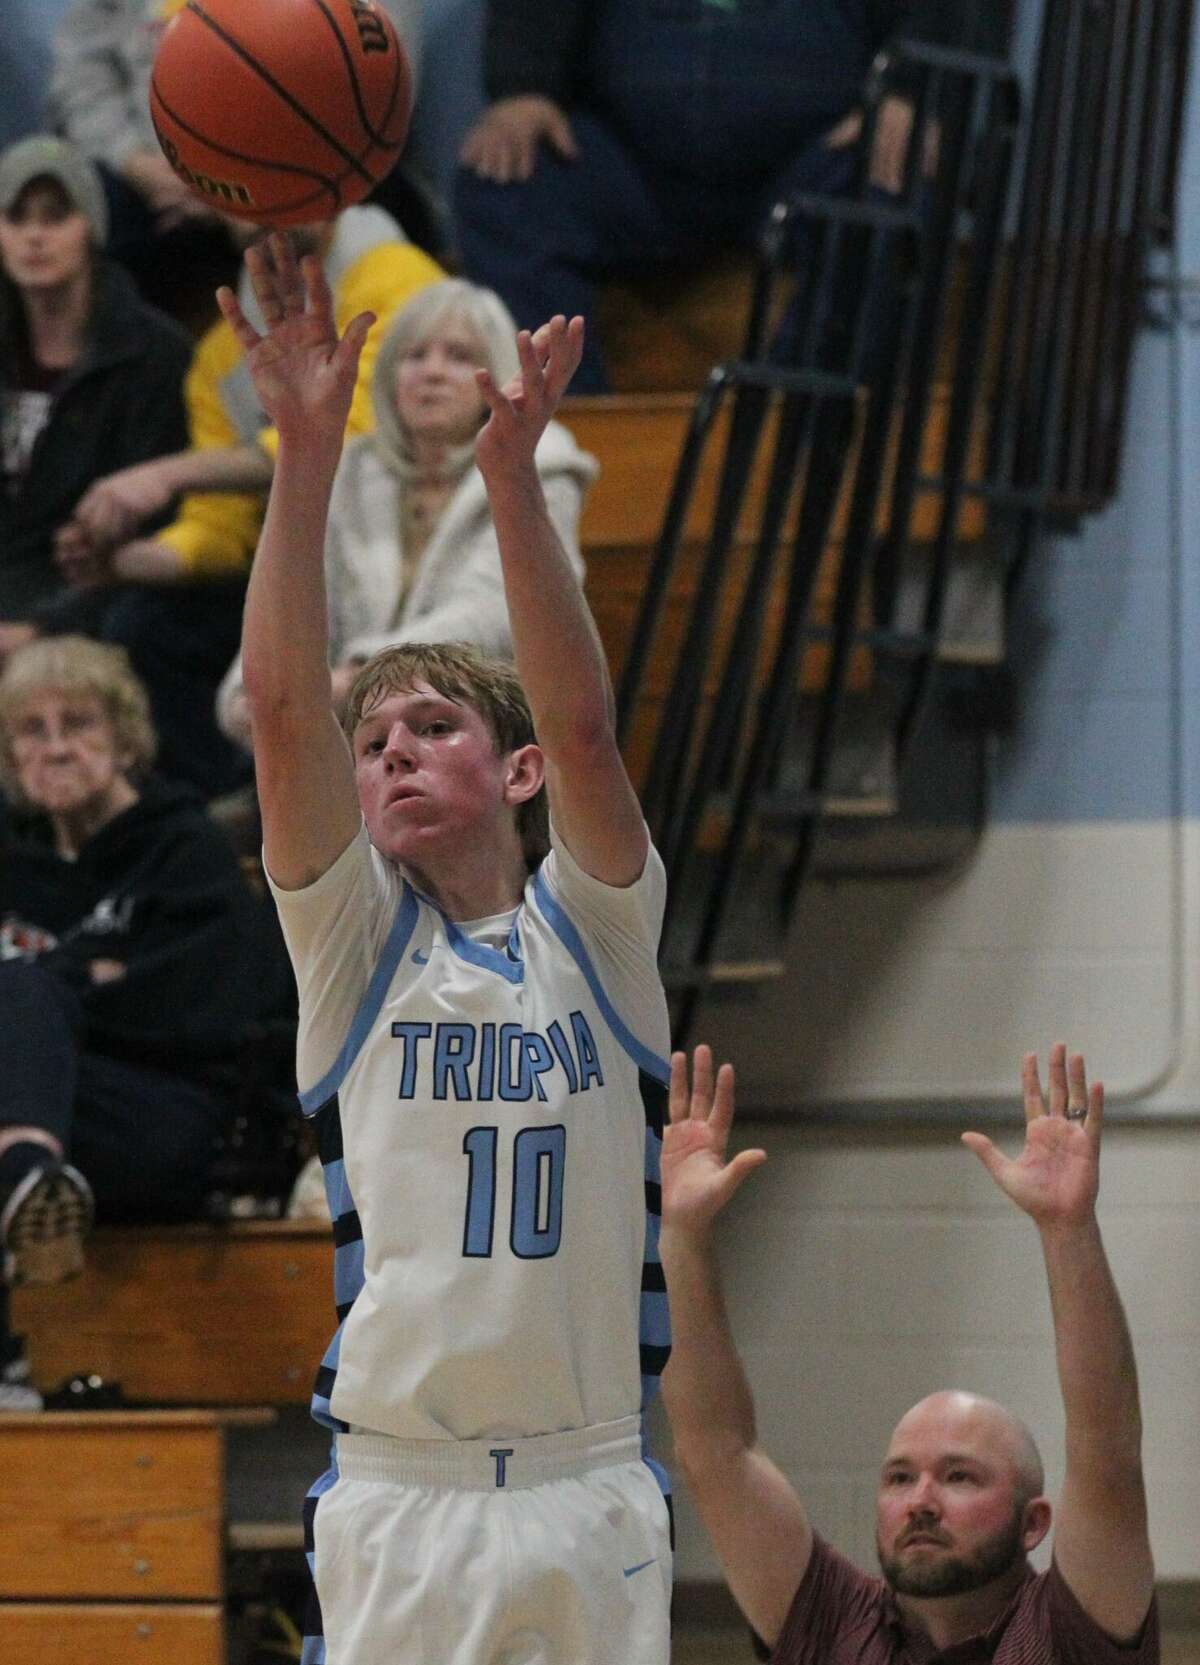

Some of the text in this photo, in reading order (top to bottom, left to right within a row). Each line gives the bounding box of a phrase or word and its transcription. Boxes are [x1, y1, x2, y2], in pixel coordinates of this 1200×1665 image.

[391, 1010, 604, 1102] TRIOPIA
[462, 1124, 566, 1260] 10
[489, 1448, 514, 1488] T
